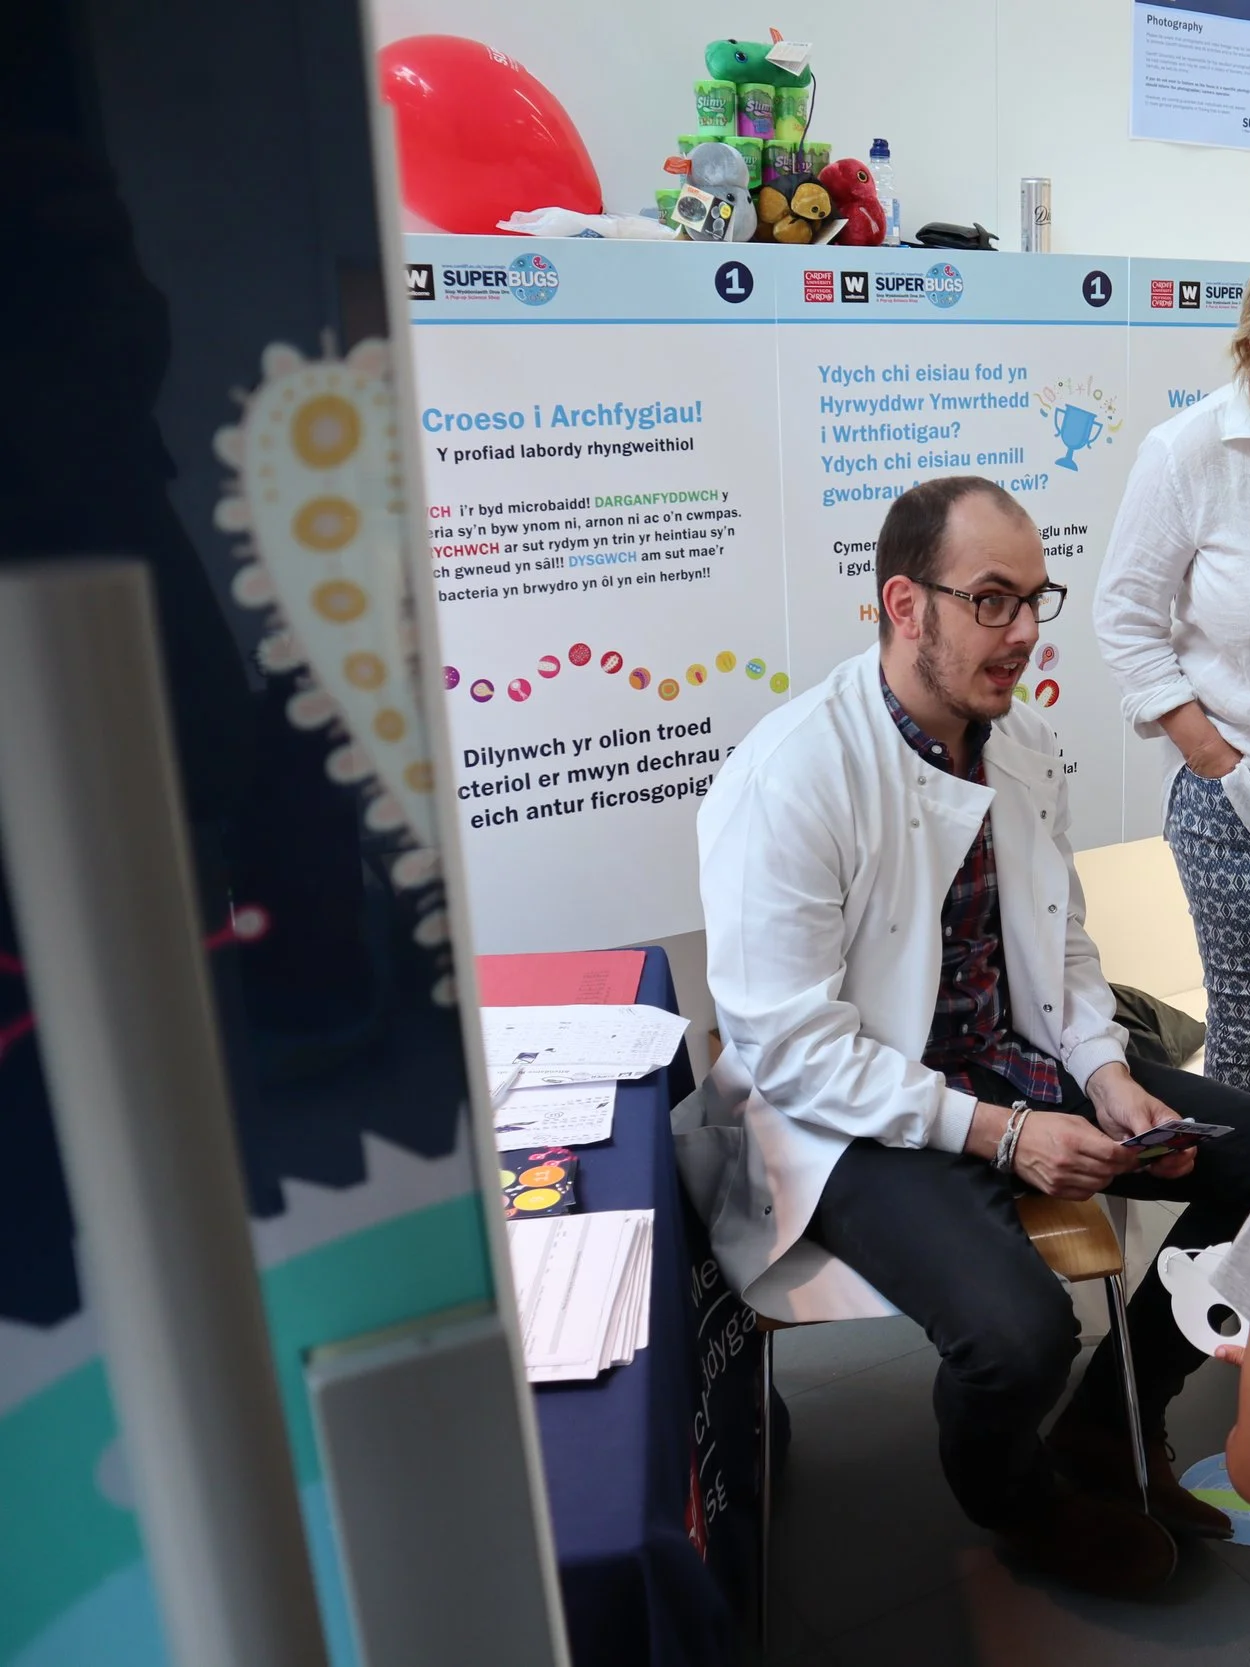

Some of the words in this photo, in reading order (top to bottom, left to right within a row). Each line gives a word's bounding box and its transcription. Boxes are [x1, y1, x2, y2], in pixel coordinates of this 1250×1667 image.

[1147, 15, 1203, 33] Photography
[726, 268, 745, 294] 1
[845, 276, 864, 293] W
[1091, 277, 1105, 299] 1
[1182, 286, 1197, 300] W
[1206, 286, 1243, 299] SUPER
[818, 365, 875, 387] Ydych
[882, 364, 910, 382] chi
[916, 364, 970, 382] eisiau
[975, 363, 1003, 381] fod
[1008, 367, 1027, 384] yn
[422, 407, 525, 432] Croeso
[534, 405, 541, 428] i
[551, 401, 702, 430] Archfygiau!
[820, 393, 925, 417] Hyrwyddwr
[929, 391, 1029, 411] Ymwrthedd
[821, 426, 826, 443] i
[832, 421, 961, 444] Wrthfiotigau?
[436, 448, 448, 461] Y
[454, 444, 515, 464] profiad
[521, 440, 582, 460] labordy
[587, 437, 694, 457] rhyngweithiol
[821, 455, 878, 476] Ydych
[884, 452, 911, 470] chi
[917, 450, 971, 469] eisiau
[976, 447, 1024, 466] ennill
[428, 506, 451, 519] CH
[460, 504, 474, 517] i'r
[478, 502, 503, 519] byd
[508, 498, 590, 514] microbaidd!
[594, 490, 719, 508] DARGANFYDDWCH
[722, 491, 729, 502] y
[822, 484, 904, 507] gwobrau
[1011, 473, 1049, 492] cŵl?
[458, 523, 487, 539] sy'n
[491, 522, 518, 537] byw
[522, 520, 560, 535] ynom
[564, 517, 581, 531] ni,
[585, 516, 623, 529] arnon
[628, 513, 640, 526] ni
[643, 513, 659, 524] ac
[663, 510, 682, 523] o'n
[686, 508, 742, 523] cwmpas.
[504, 542, 518, 553] ar
[522, 539, 544, 552] sut
[548, 535, 589, 552] rydym
[593, 536, 608, 548] yn
[612, 532, 635, 545] trin
[639, 532, 651, 546] yr
[654, 526, 707, 542] heintiau
[710, 525, 735, 540] sy'n
[833, 541, 877, 555] Cymer
[1063, 524, 1088, 536] nhw
[454, 562, 511, 580] gwneud
[515, 561, 531, 575] yn
[535, 556, 564, 570] sâl!!
[568, 551, 637, 568] DYSGWCH
[641, 549, 661, 562] am
[665, 547, 685, 559] sut
[688, 545, 724, 558] mae'r
[839, 563, 842, 574] i
[847, 560, 875, 577] gyd.
[1076, 544, 1084, 554] a
[438, 586, 498, 602] bacteria
[502, 585, 518, 599] yn
[523, 579, 578, 596] brwydro
[582, 578, 597, 591] yn
[601, 574, 613, 588] ôl
[617, 574, 632, 588] yn
[636, 571, 656, 584] ein
[659, 567, 711, 584] herbyn!!
[463, 738, 565, 768] Dilynwch
[572, 736, 592, 756] yr
[599, 728, 650, 749] olion
[657, 717, 712, 742] troed
[457, 772, 531, 800] cteriol
[538, 771, 560, 787] er
[567, 761, 630, 784] mwyn
[637, 747, 720, 773] dechrau
[470, 805, 518, 829] eich
[526, 797, 584, 820] antur
